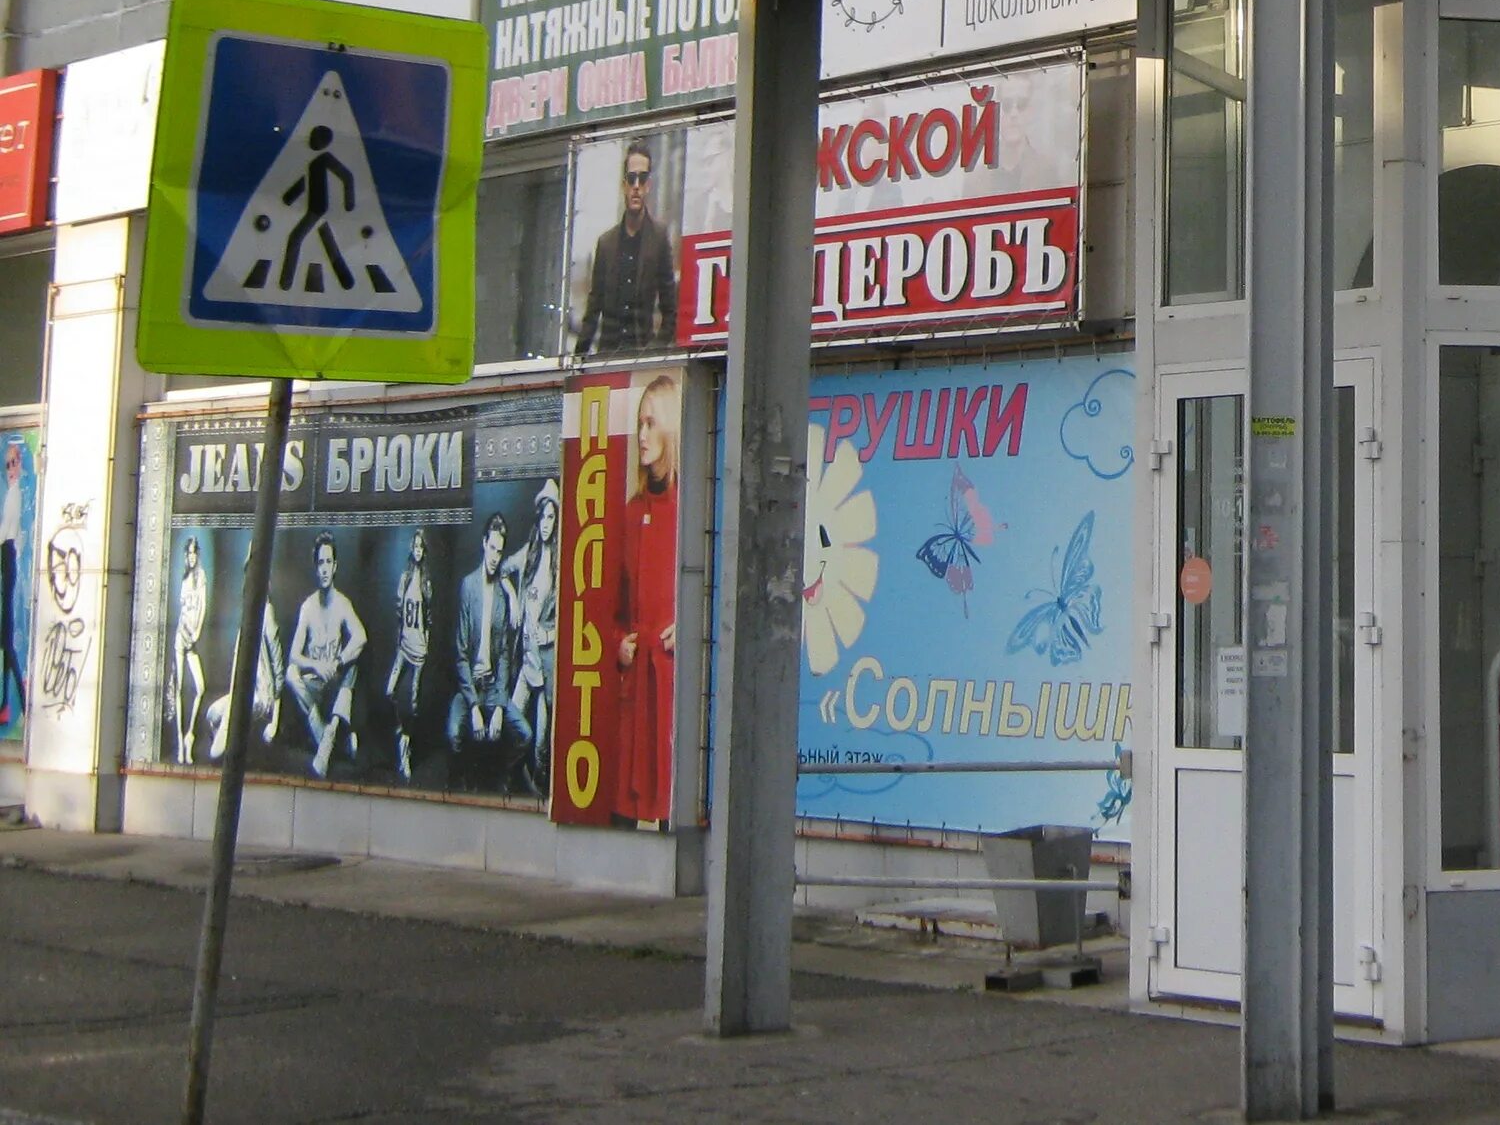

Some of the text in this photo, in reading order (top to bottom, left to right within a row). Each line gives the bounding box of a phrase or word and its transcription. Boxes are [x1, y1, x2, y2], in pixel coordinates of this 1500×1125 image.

[486, 66, 568, 137] ДВЕРИ
[577, 51, 647, 112] ОКНА
[694, 218, 1070, 325] ГДЕРОБЪ
[327, 430, 463, 494] БРЮКИ
[566, 385, 610, 809] ПАЛЬТО
